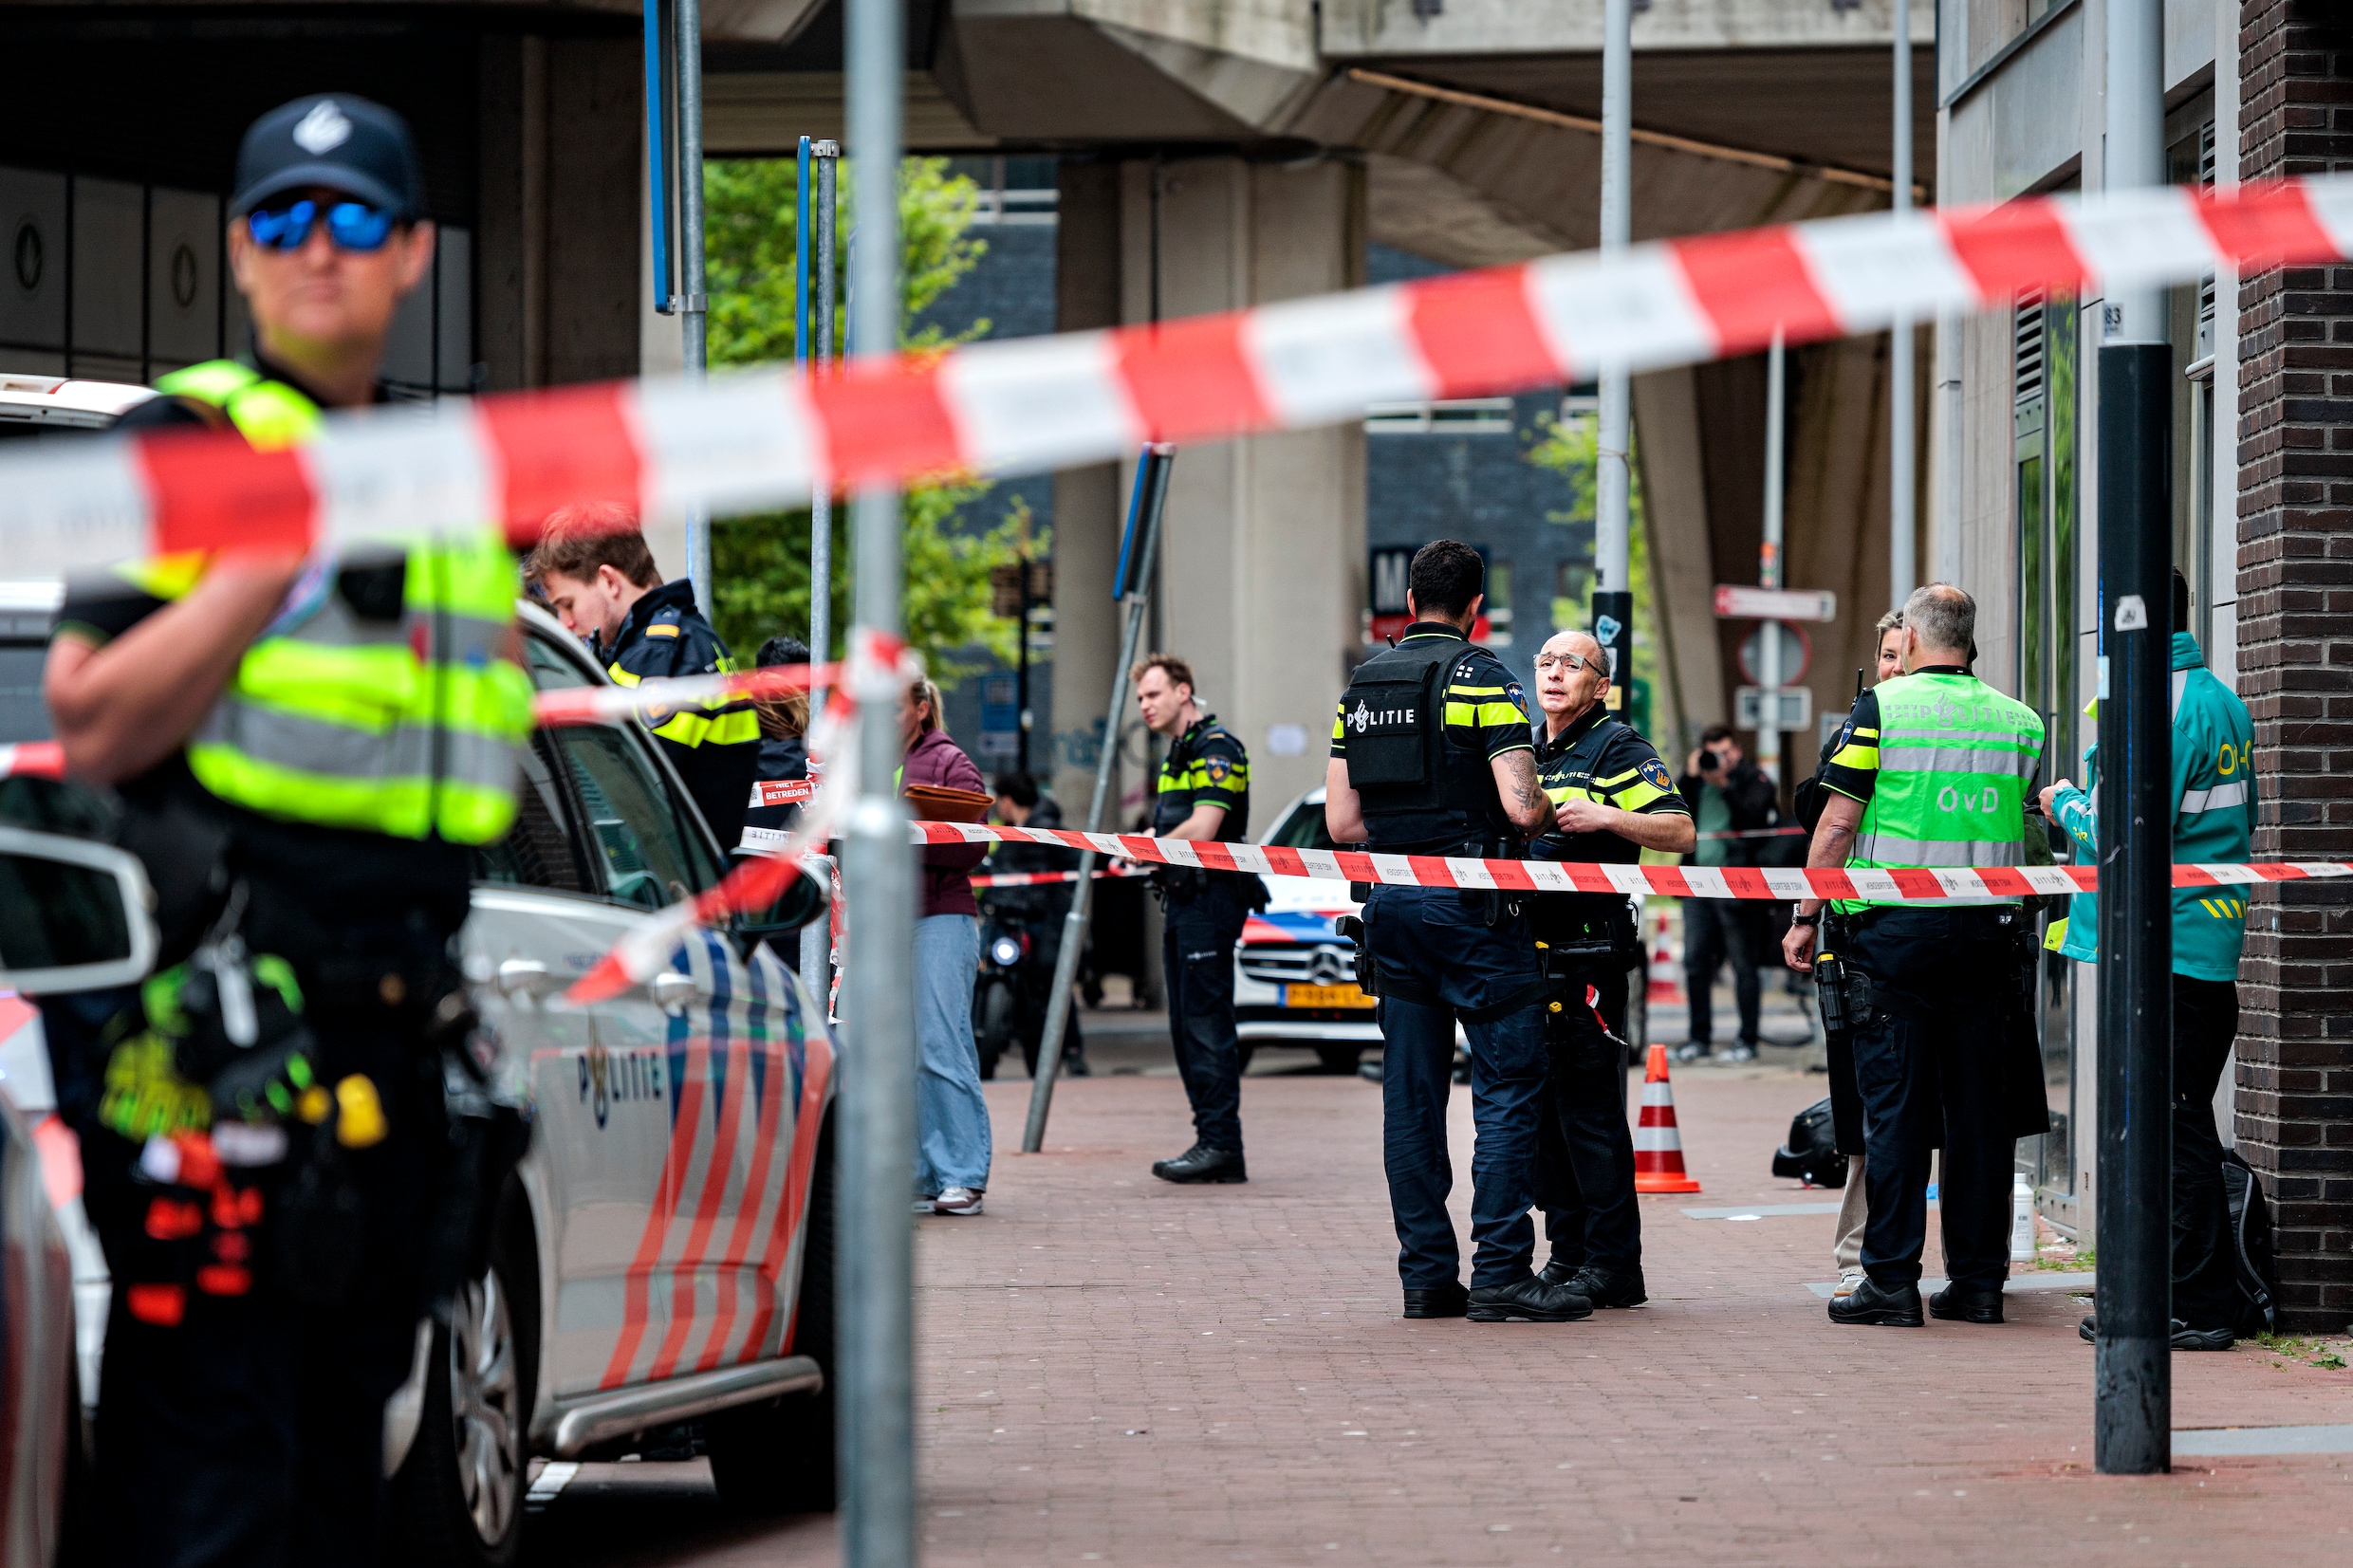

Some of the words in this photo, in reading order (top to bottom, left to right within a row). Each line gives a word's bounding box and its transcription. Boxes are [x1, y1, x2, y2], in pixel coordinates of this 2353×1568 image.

[1346, 698, 1415, 733] POLITIE
[1920, 692, 2015, 727] POLITIE
[766, 787, 809, 801] BETREDEN
[1937, 786, 1999, 813] OvD
[577, 1024, 662, 1130] POLITIE
